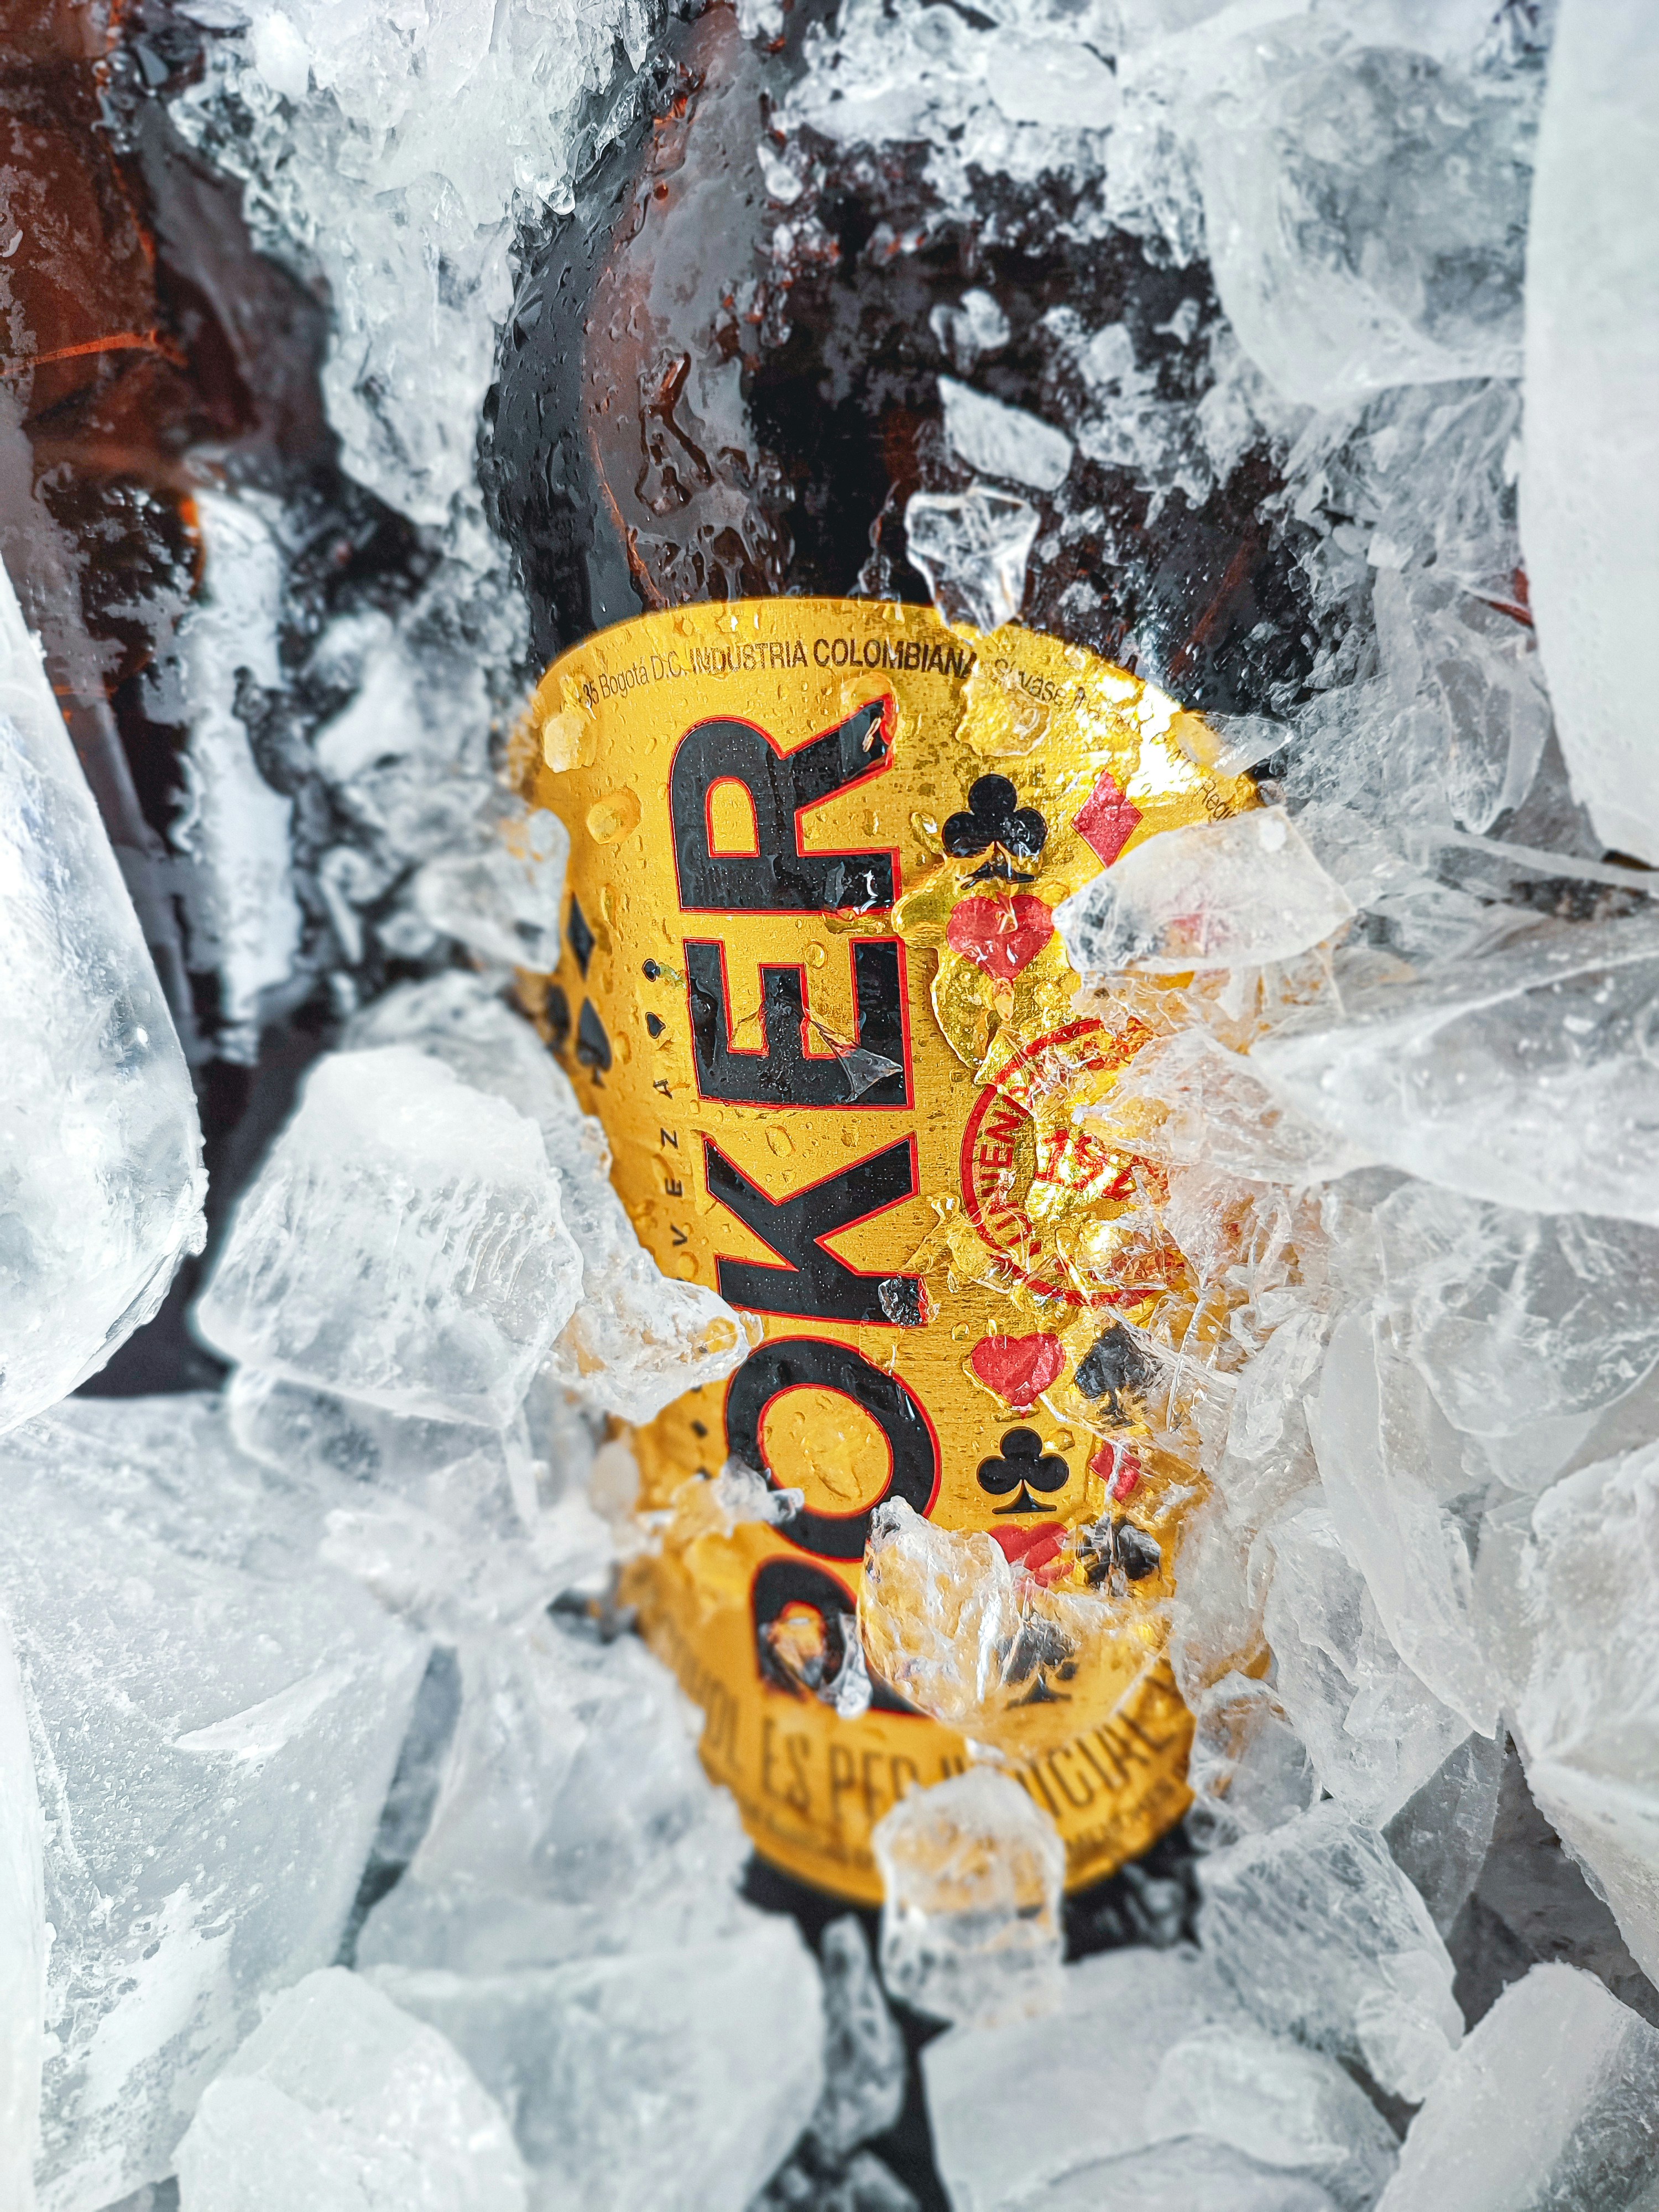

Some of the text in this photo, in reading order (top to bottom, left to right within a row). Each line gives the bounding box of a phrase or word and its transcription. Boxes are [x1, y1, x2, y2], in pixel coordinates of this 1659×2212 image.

[598, 656, 650, 700] Bogotá
[690, 639, 808, 675] INDUSTRIA
[668, 696, 942, 1717] POKER
